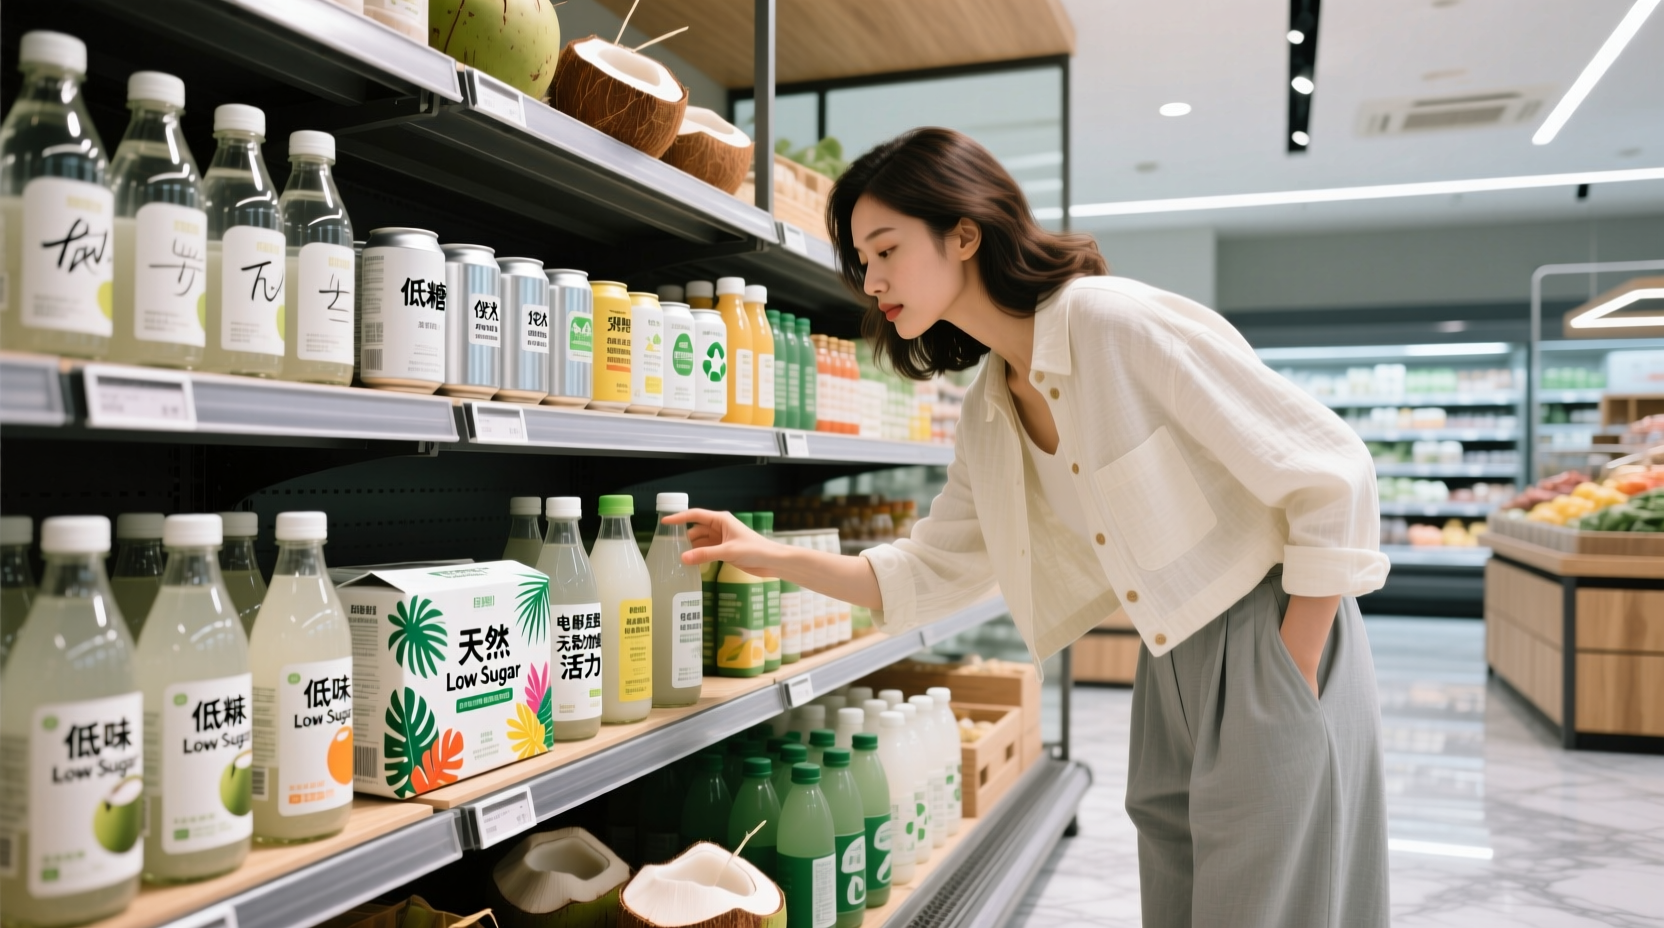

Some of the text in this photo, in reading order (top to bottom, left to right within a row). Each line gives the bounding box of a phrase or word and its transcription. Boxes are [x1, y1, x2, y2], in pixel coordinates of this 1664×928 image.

[400, 276, 447, 311] 低糖
[458, 623, 511, 666] 天然
[446, 664, 521, 692] Low Sugar
[560, 652, 601, 680] 活力
[303, 674, 352, 709] 低味
[294, 714, 323, 729] Low
[63, 717, 132, 759] 低味
[183, 738, 218, 754] Low
[52, 765, 93, 784] Low
